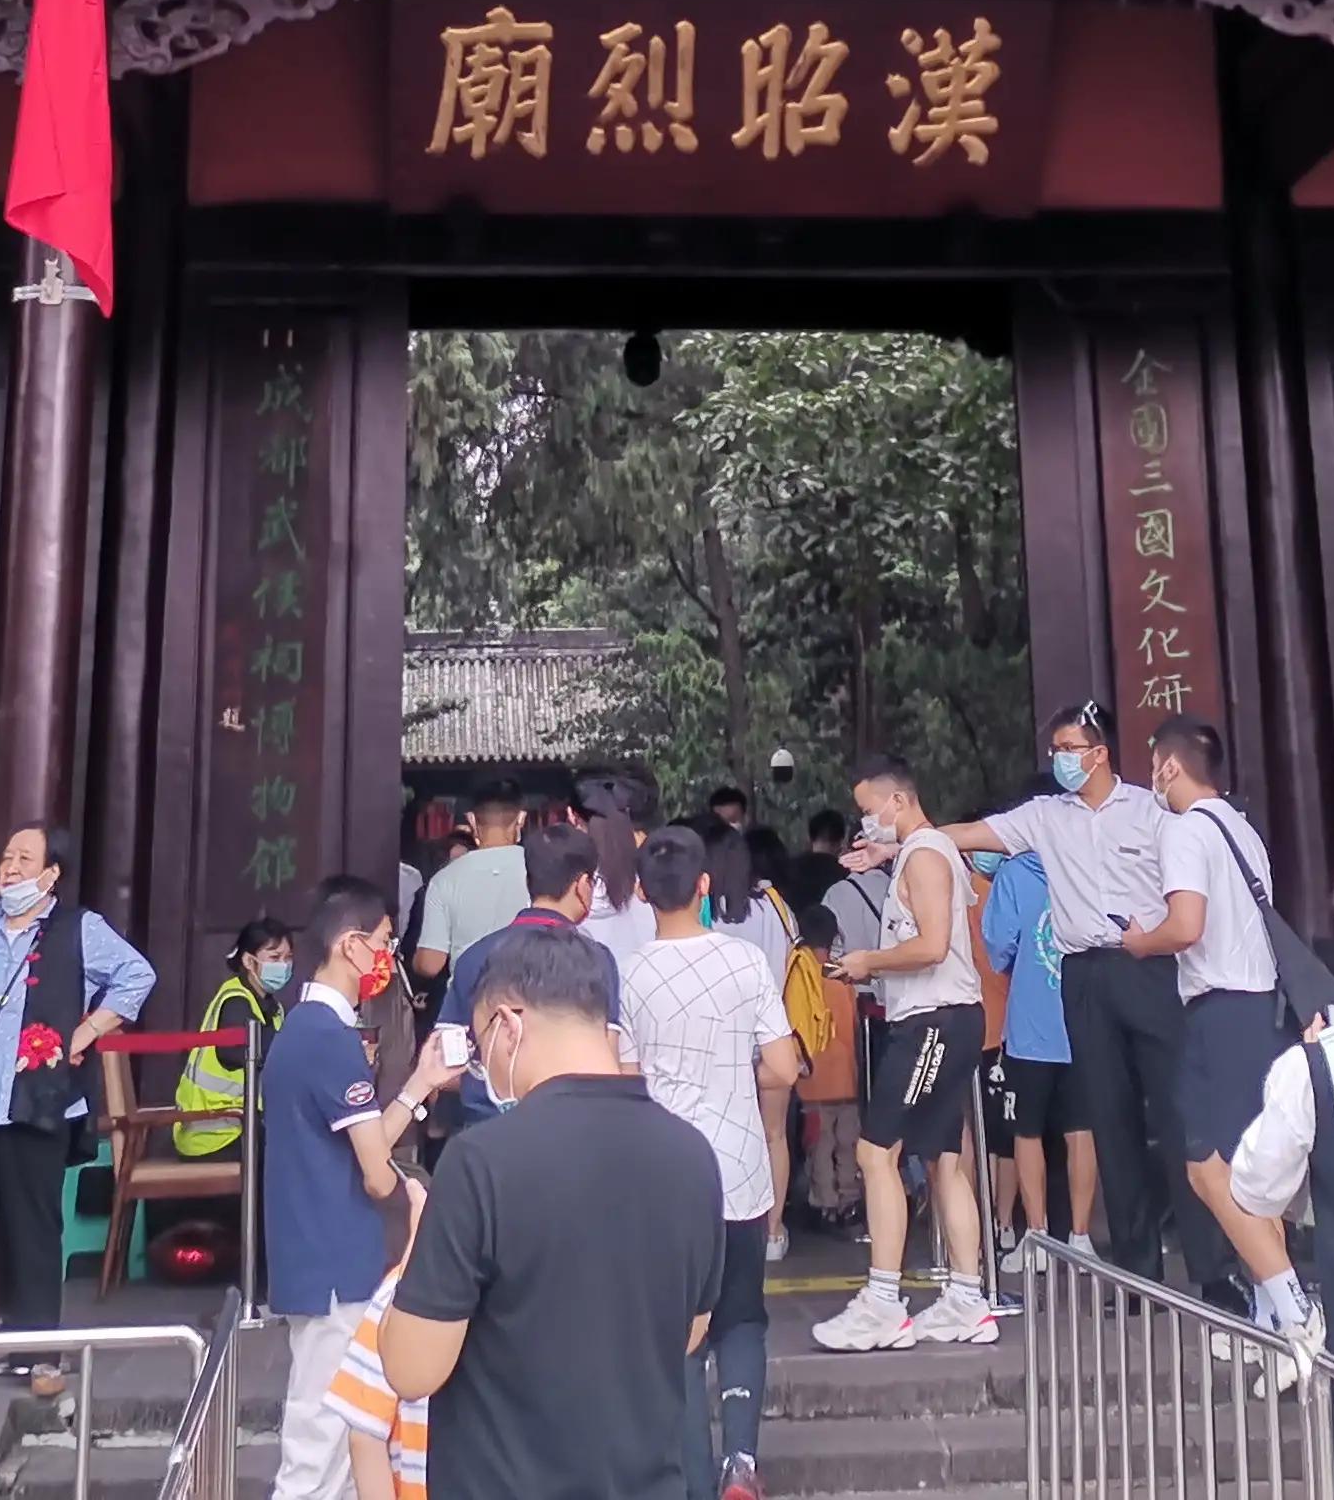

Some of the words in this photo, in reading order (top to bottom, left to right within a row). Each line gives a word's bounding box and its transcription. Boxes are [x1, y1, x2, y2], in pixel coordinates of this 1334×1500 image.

[1121, 348, 1193, 748] 全國三國文化研
